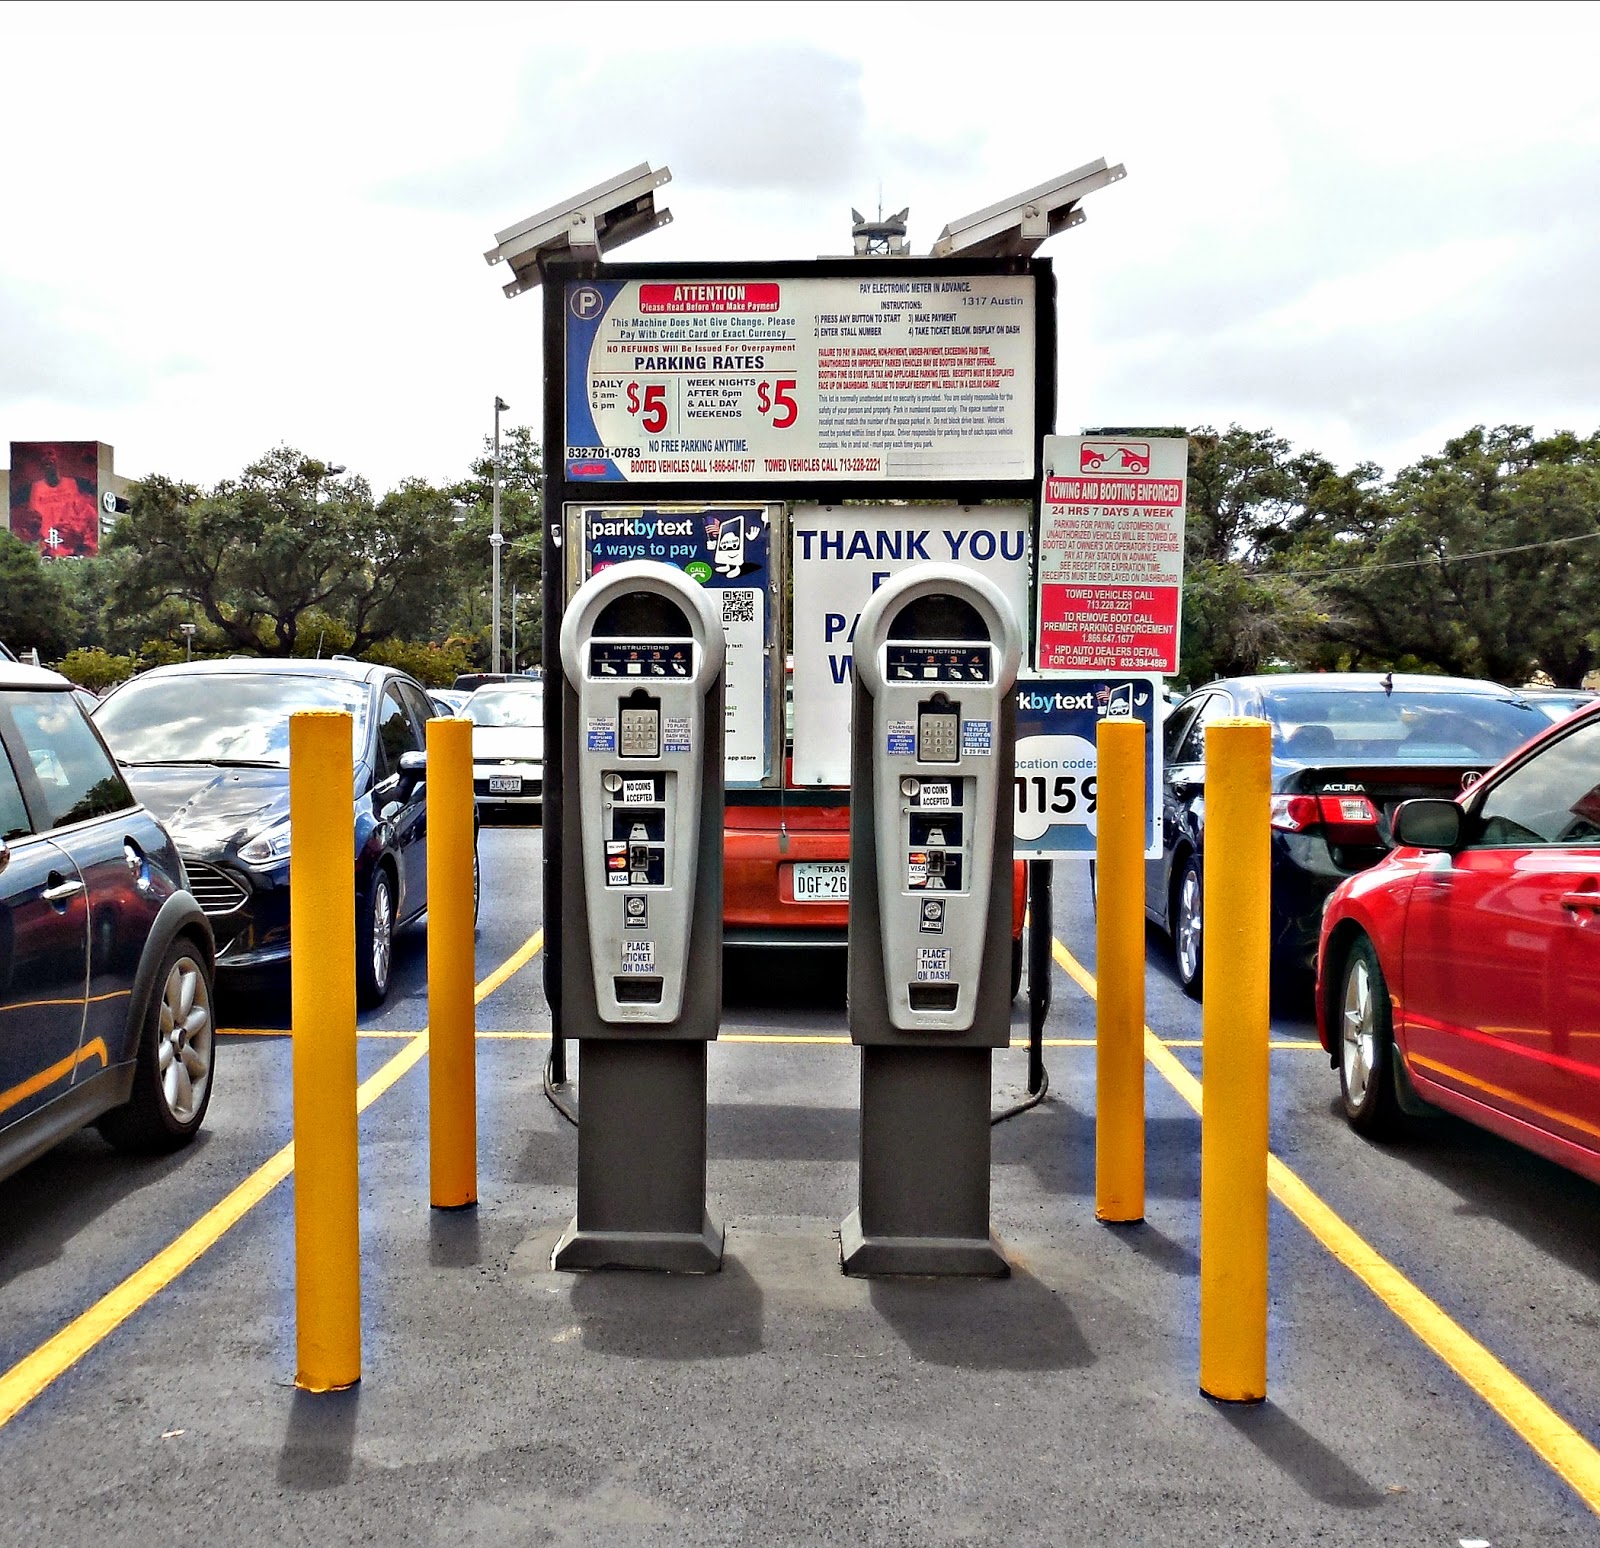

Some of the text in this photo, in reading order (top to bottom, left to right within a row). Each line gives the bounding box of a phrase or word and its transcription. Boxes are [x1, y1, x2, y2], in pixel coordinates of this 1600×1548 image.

[674, 286, 745, 300] ATTENTION
[860, 283, 971, 293] PAY ELECTRONIC METER IN ADVANCE.
[580, 293, 596, 314] P
[641, 303, 664, 311] Please
[667, 303, 684, 311] Read
[686, 303, 709, 311] Before
[727, 302, 745, 310] Make
[748, 302, 777, 311] Payment
[612, 317, 795, 328] This Machine Does Not Give Change. Please
[815, 314, 900, 324] 1) PRESS ANY BUTTON TO START
[909, 313, 956, 324] 3) MAKE PAYMENT
[620, 330, 635, 341] Pay
[638, 330, 657, 339] With
[660, 330, 686, 339] Credit
[689, 330, 708, 338] Card
[723, 330, 746, 338] Exact
[749, 329, 786, 339] Currency
[814, 327, 881, 337] 2) ENTER STALL NUMBER
[909, 327, 913, 336] 4)
[915, 327, 929, 335] TAKE
[930, 326, 950, 335] TICKET
[973, 326, 995, 334] DISPLAY
[1006, 326, 1020, 334] DASH
[742, 344, 795, 353] Overpayment
[634, 356, 764, 370] PARKING RATES
[722, 390, 742, 398] 6pm
[649, 440, 748, 452] NO FREE PARKING ANYTIME.
[631, 460, 755, 473] BOOTED VEHICLES CALL 1-866-647-1677
[765, 458, 880, 472] TOWED VEHICLES CALL 713-228-2221
[1050, 482, 1178, 501] TOWING AND BOOTING ENFORCED
[1103, 508, 1129, 516] DAYS
[1144, 509, 1173, 517] WEEK
[593, 519, 693, 539] parkbytext
[796, 530, 1024, 560] THANK YOU
[593, 544, 697, 558] 4 ways to pay
[1065, 590, 1154, 600] TOWED VEHICLES CALL
[1087, 601, 1132, 609] 713.228.2221
[1064, 612, 1154, 623] TO REMOVE BOOT CALL
[1044, 623, 1173, 634] PREMIER PARKING ENFORCEMENT
[1055, 646, 1159, 656] HPD AUTO DEALERS DETAIL
[1067, 656, 1115, 665] COMPLAINTS
[1121, 658, 1167, 667] 832-394-4869
[1016, 692, 1094, 713] kbytext
[1015, 759, 1096, 768] ocation code:
